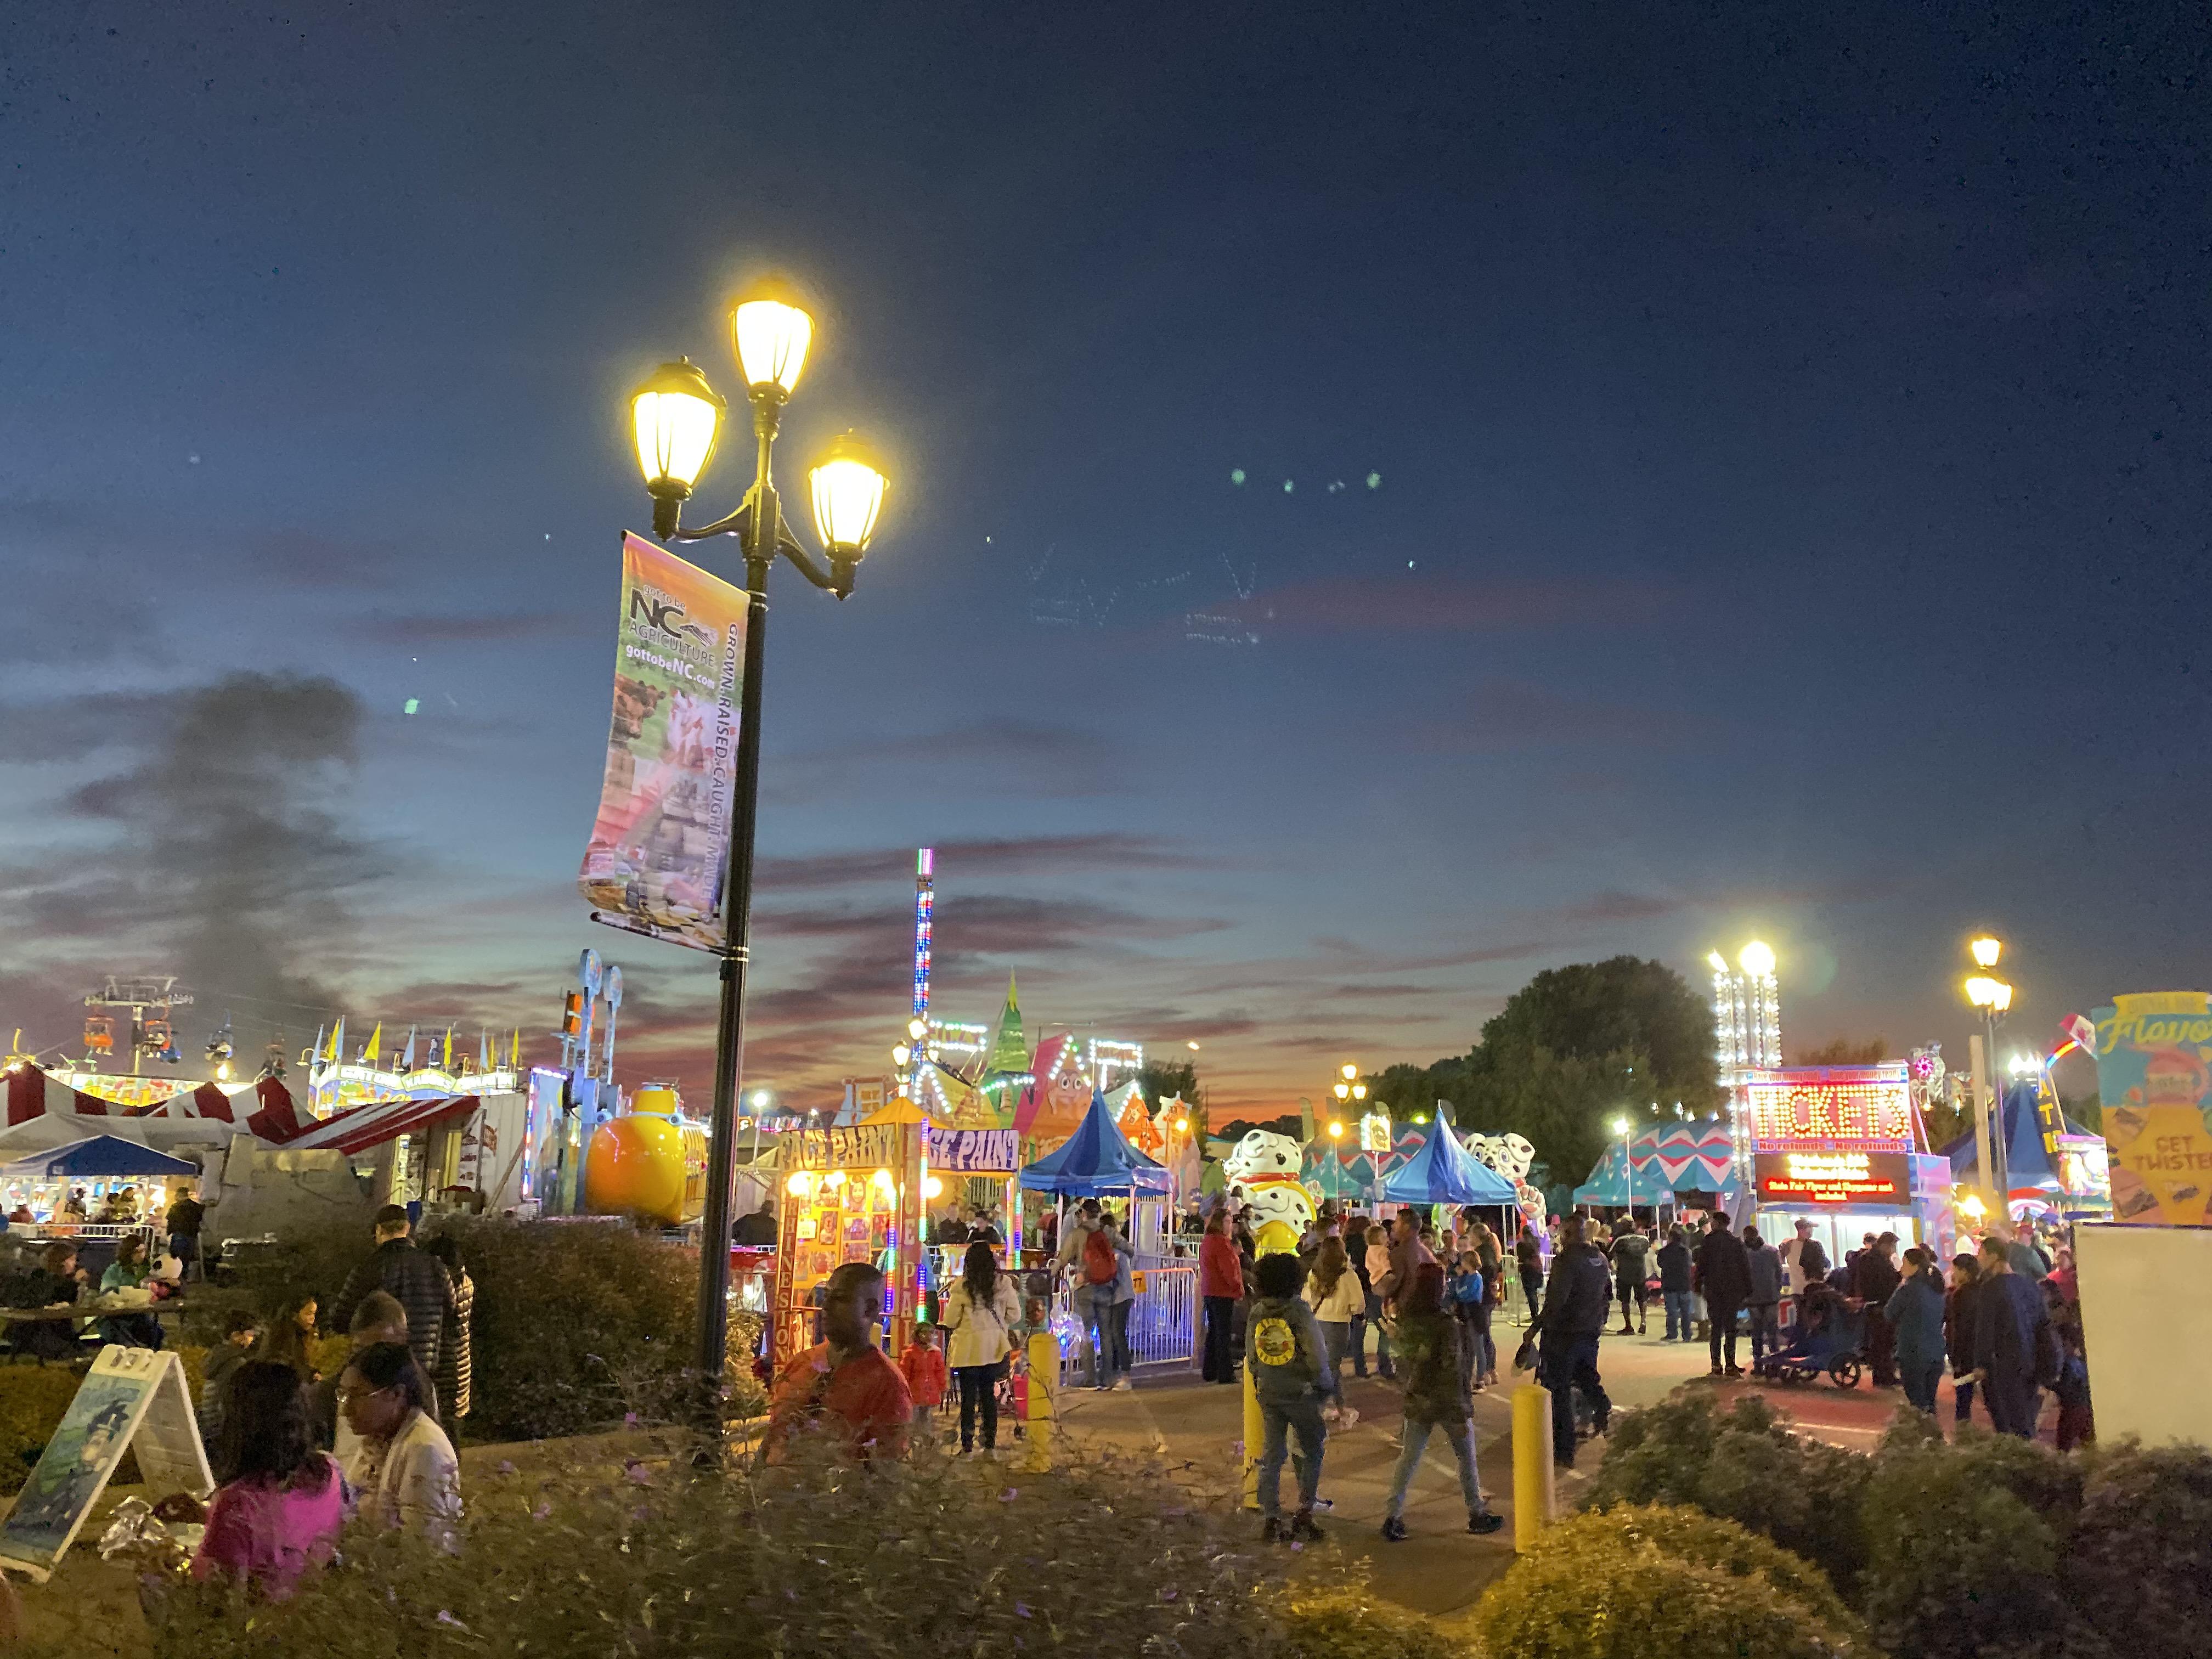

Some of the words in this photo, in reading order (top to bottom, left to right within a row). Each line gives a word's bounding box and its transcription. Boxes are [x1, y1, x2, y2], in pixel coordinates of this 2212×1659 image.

[630, 588, 684, 639] NC
[643, 585, 660, 596] got
[662, 592, 672, 604] to
[674, 596, 686, 610] be
[629, 621, 715, 668] AGRICULTURE
[626, 645, 715, 690] gottobeNC.com
[2097, 1016, 2212, 1054] Flavo
[1753, 1086, 1909, 1138] TICKETS
[778, 1130, 827, 1171] FACE
[830, 1124, 894, 1169] PAINT
[956, 1130, 1019, 1170] PAINT
[1758, 1142, 1775, 1150] No
[1776, 1142, 1827, 1151] refunds
[1835, 1142, 1853, 1150] No
[1854, 1142, 1907, 1151] refunds
[2133, 1153, 2212, 1171] TWISTE
[2155, 1136, 2196, 1152] GET
